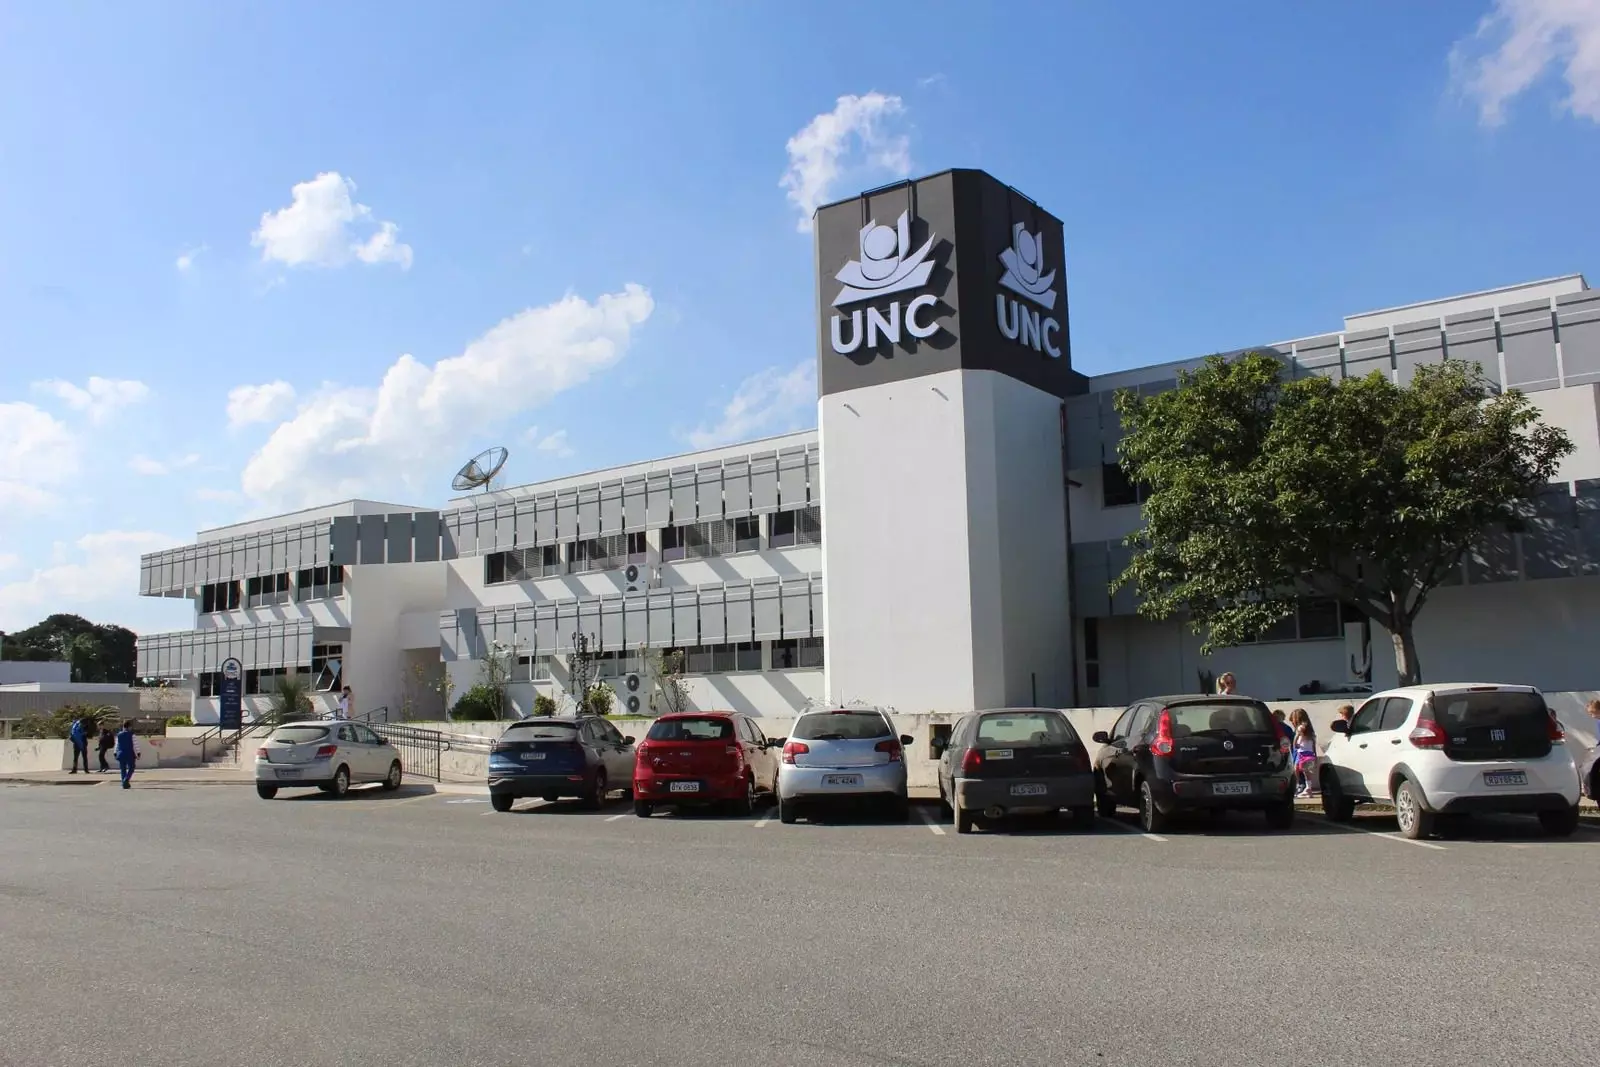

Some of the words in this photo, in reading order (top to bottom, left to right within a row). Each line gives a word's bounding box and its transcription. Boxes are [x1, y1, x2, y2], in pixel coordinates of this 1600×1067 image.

[831, 294, 941, 354] UNC
[996, 293, 1061, 358] UNC
[1490, 729, 1505, 741] FIAT
